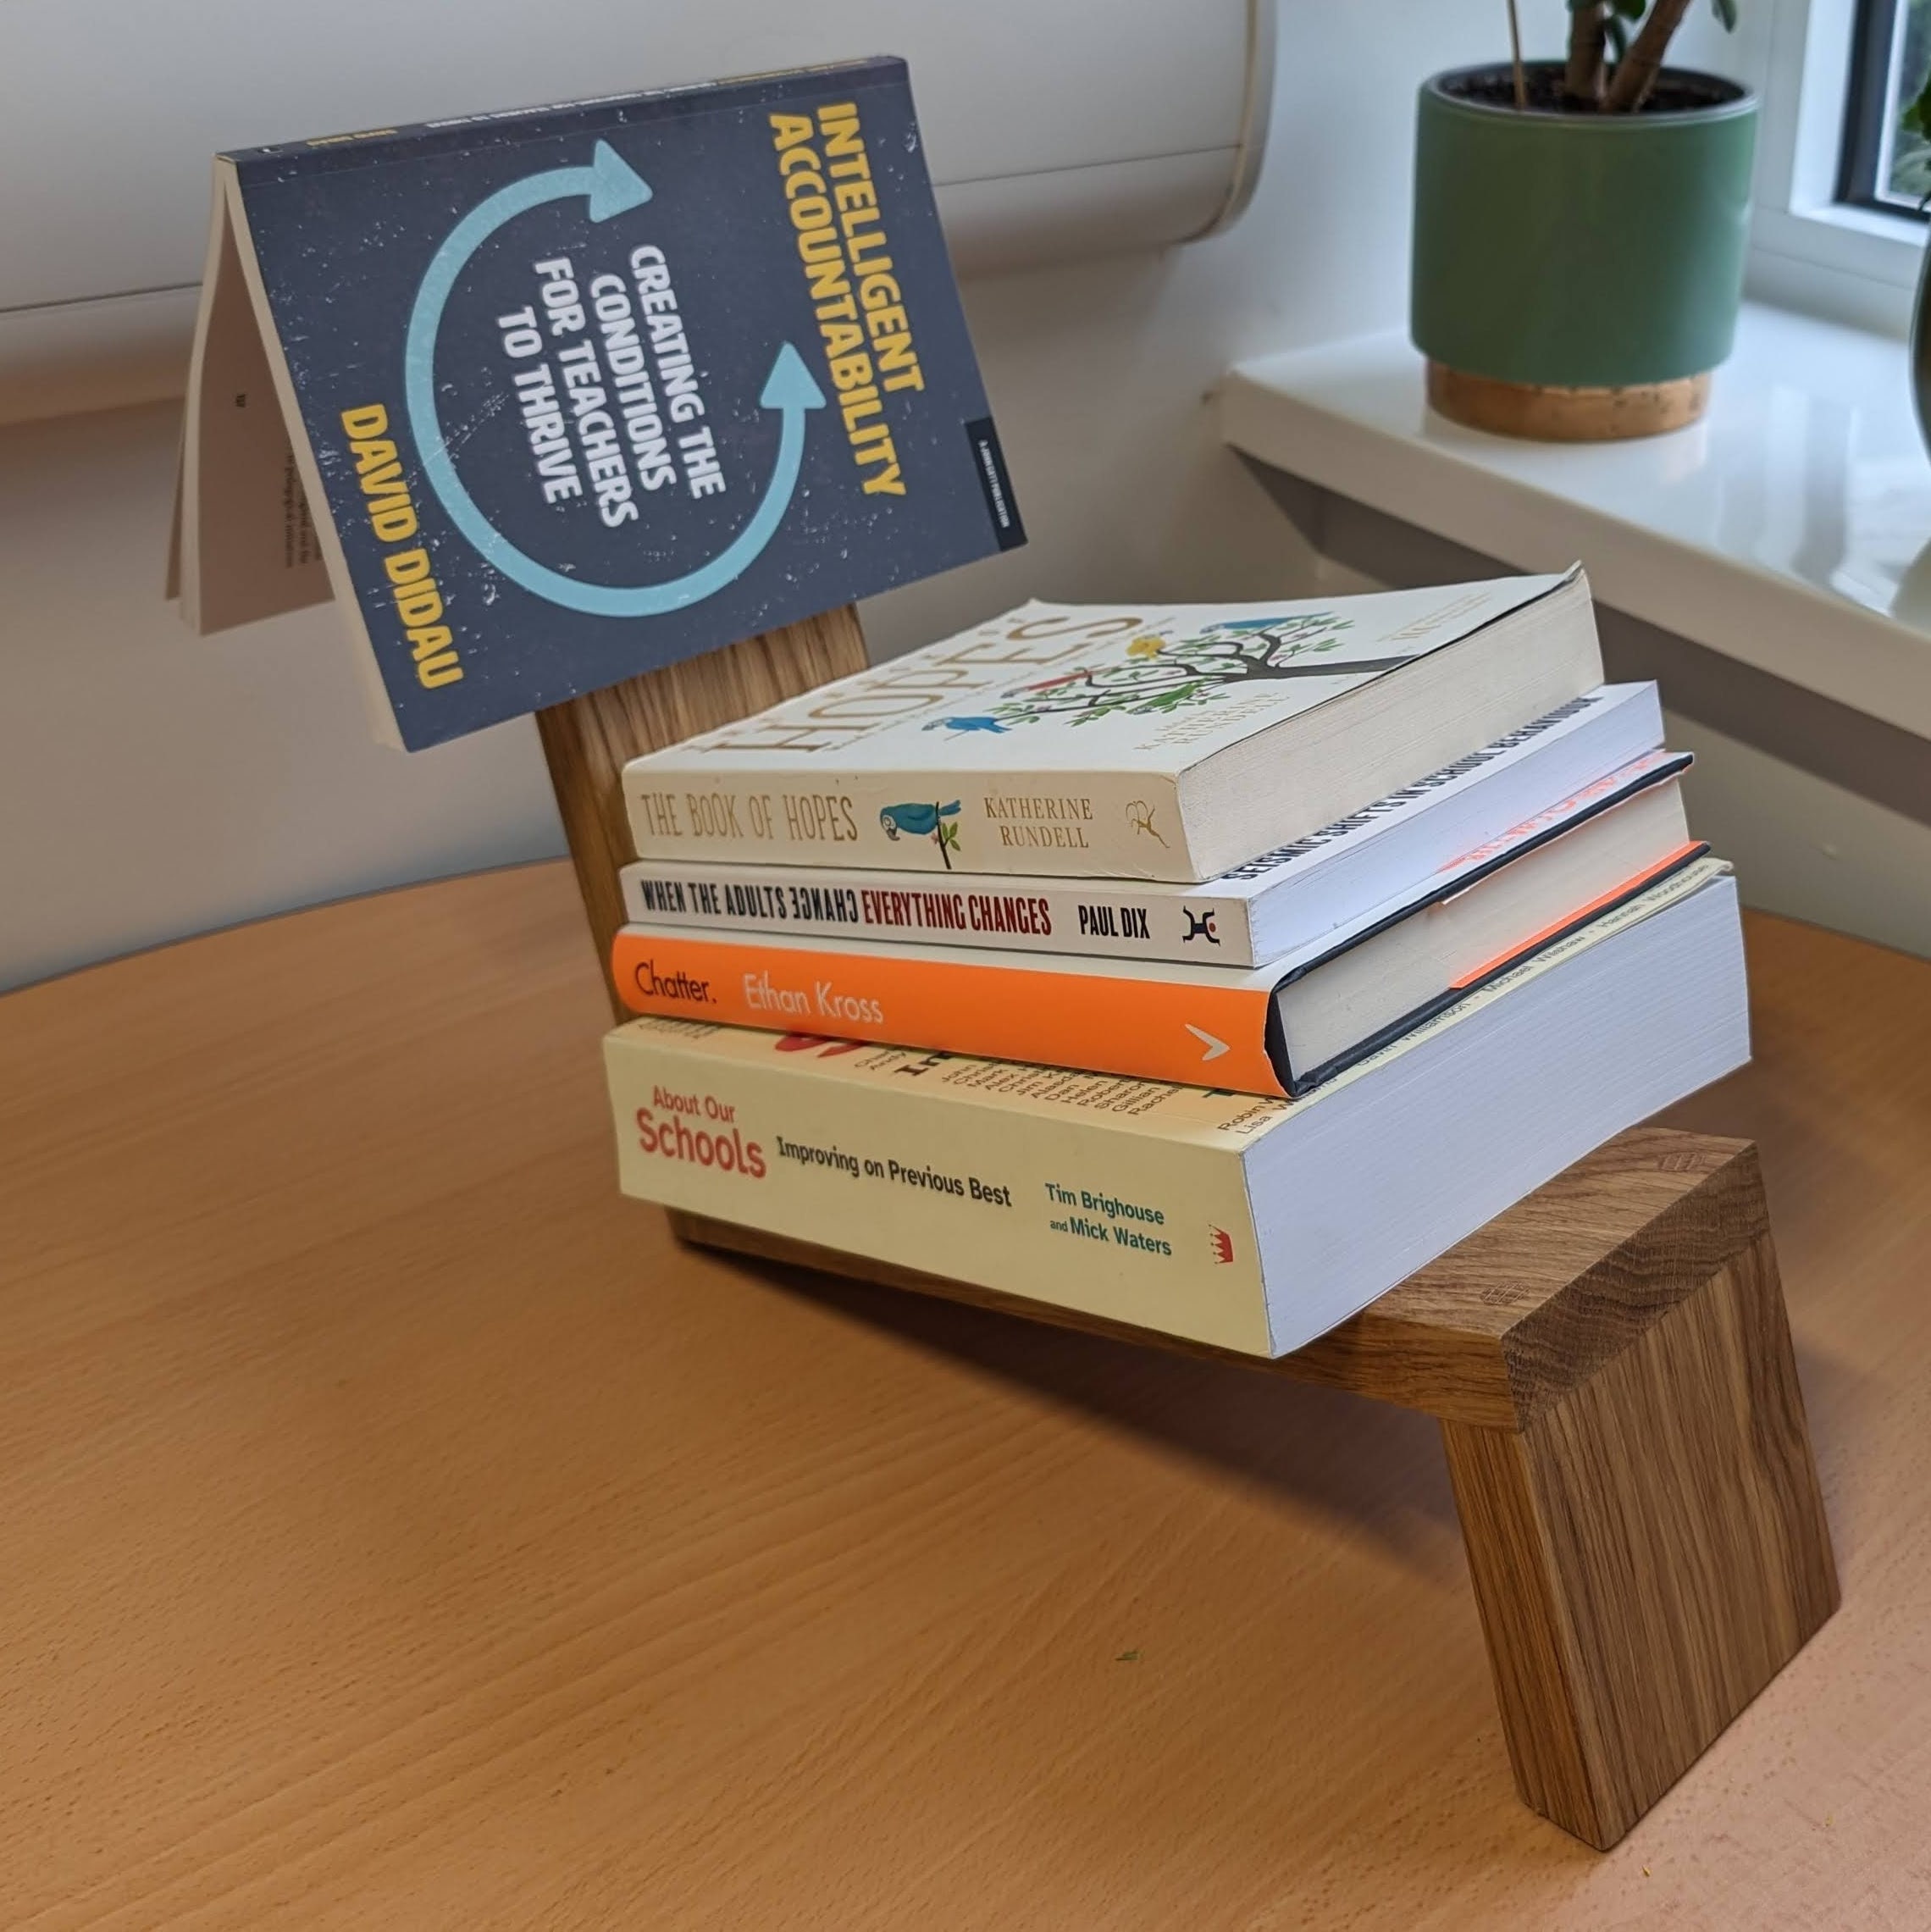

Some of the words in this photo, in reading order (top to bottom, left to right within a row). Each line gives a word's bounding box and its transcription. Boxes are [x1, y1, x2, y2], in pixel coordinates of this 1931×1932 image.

[817, 101, 925, 392] INTELLIGENT
[534, 257, 587, 337] FOR
[768, 111, 907, 495] ACCOUNTABILITY
[497, 306, 543, 359] TO
[591, 273, 678, 491] CONDITIONS
[630, 244, 705, 423] CREATING
[678, 425, 727, 500] THE
[514, 363, 584, 504] THRIVE
[559, 339, 639, 529] TEACHERS
[340, 402, 419, 543] DAVID
[384, 548, 464, 690] DIDAU
[713, 616, 1143, 752] HOPES
[640, 794, 683, 837] THE
[687, 793, 744, 839] BOOK
[749, 794, 775, 840] OF
[783, 794, 858, 842] HOPES
[984, 797, 1093, 821] KATHERINE
[1220, 830, 1333, 880] SEISMIC
[1326, 800, 1407, 837] SHIFTS
[1388, 789, 1431, 800] IN
[1413, 750, 1507, 788] SCHOOL
[1000, 827, 1089, 849] RUNDELL
[640, 879, 686, 912] WHEN
[688, 882, 722, 915] THE
[726, 885, 787, 920] ADULTS
[862, 889, 966, 930] EVERYTHING
[968, 895, 1052, 936] CHANGES
[1078, 904, 1120, 937] PAUL
[1121, 907, 1150, 939] DIX
[634, 960, 717, 1005] Chatter.
[744, 971, 810, 1015] Ethan
[816, 977, 883, 1024] Kross
[942, 1064, 977, 1082] John
[1237, 1115, 1273, 1134] Lisa
[1481, 965, 1533, 994] Michael
[653, 1085, 700, 1115] About
[705, 1096, 735, 1124] Our
[967, 1069, 1010, 1088] Mark
[985, 1073, 1020, 1091] Alex
[1016, 1081, 1043, 1096] Jim
[1044, 1084, 1079, 1100] Dan
[1060, 1080, 1108, 1104] Helen
[1112, 1086, 1161, 1112] Gillian
[1217, 1102, 1265, 1131] Robin
[636, 1109, 766, 1179] Schools
[776, 1136, 860, 1177] Improving
[864, 1160, 885, 1179] on
[889, 1160, 965, 1197] Previous
[969, 1178, 1012, 1207] Best
[1044, 1182, 1077, 1206] Tim
[1081, 1190, 1165, 1226] Brighouse
[1049, 1218, 1068, 1232] and
[1070, 1216, 1109, 1242] Mick
[1113, 1226, 1172, 1256] Waters
